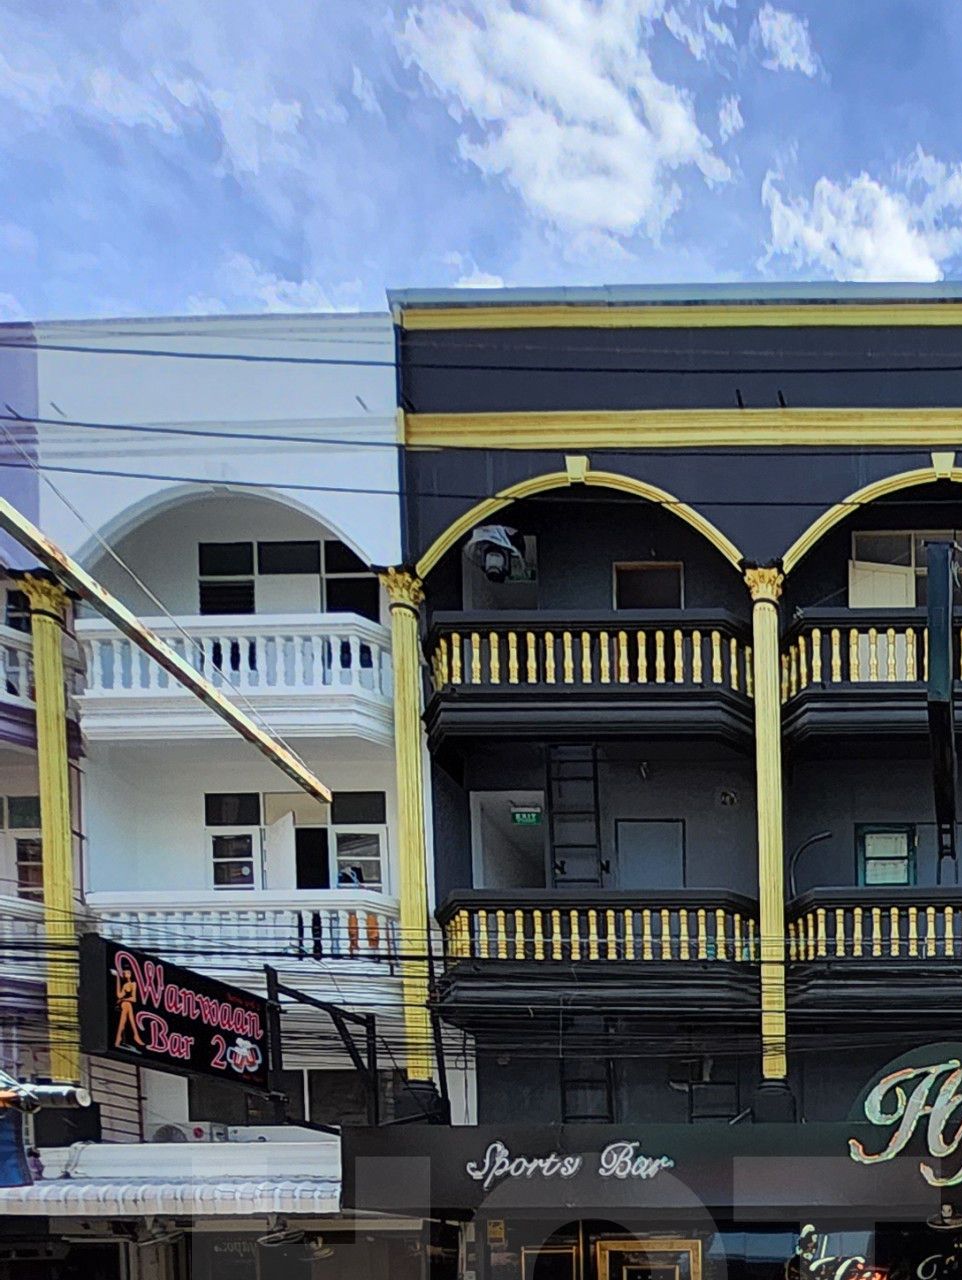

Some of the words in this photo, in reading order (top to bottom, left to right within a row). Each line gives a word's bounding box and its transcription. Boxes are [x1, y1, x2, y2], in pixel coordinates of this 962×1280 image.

[115, 951, 264, 1040] Wanwaan
[136, 1011, 195, 1060] Bar
[210, 1034, 228, 1069] 2
[466, 1141, 582, 1191] Sports
[598, 1141, 675, 1179] Bar
